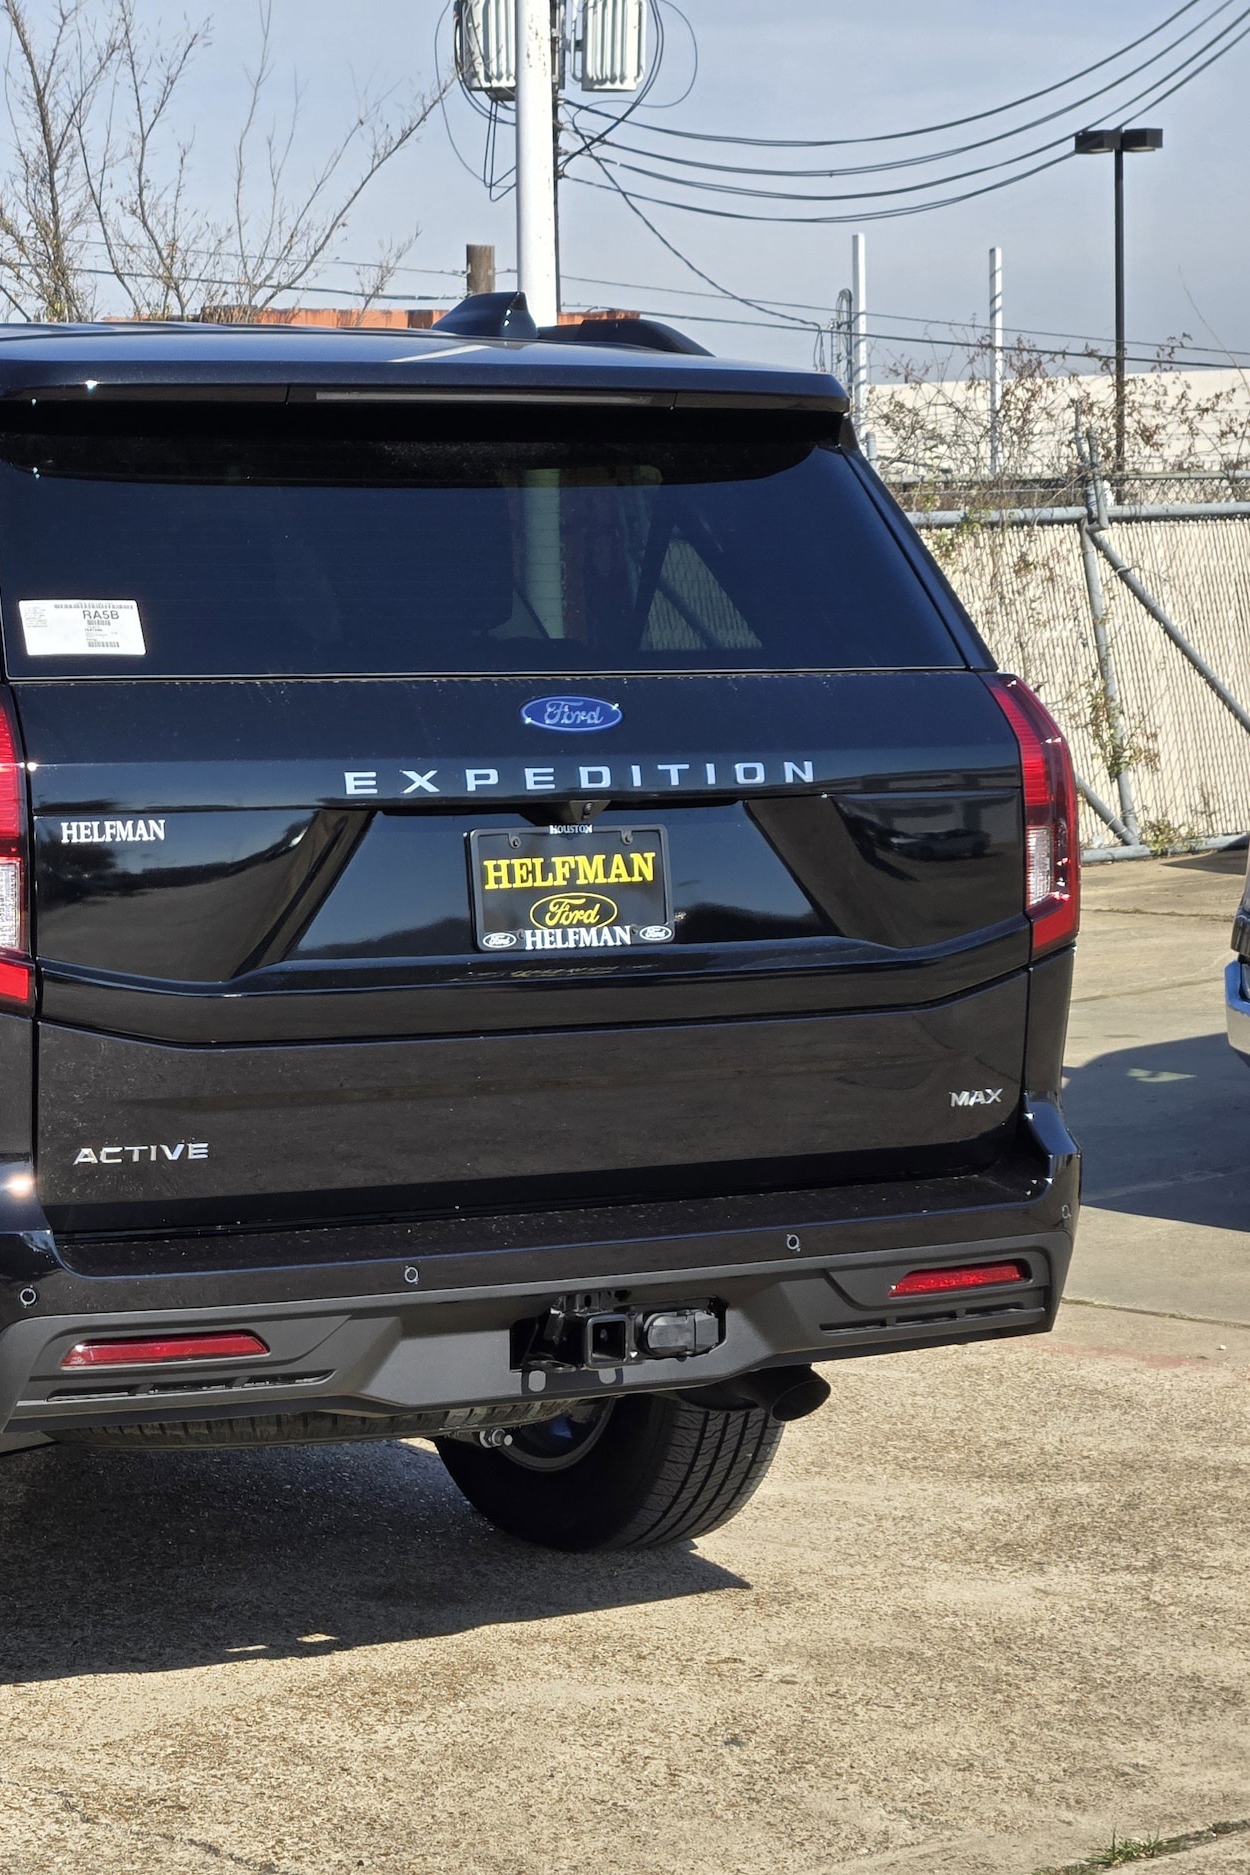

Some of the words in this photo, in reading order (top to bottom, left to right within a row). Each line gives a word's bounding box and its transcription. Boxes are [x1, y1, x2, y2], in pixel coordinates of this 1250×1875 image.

[82, 609, 120, 620] RA5B
[343, 759, 816, 796] EXPEDITION
[60, 819, 166, 844] HELFMAN
[549, 824, 593, 835] HOUSTON
[482, 851, 656, 890] HELFMAN
[544, 898, 601, 927] Ford
[524, 925, 633, 951] HELFMAN
[948, 1088, 1004, 1108] MAX
[72, 1142, 210, 1166] ACTIVE
